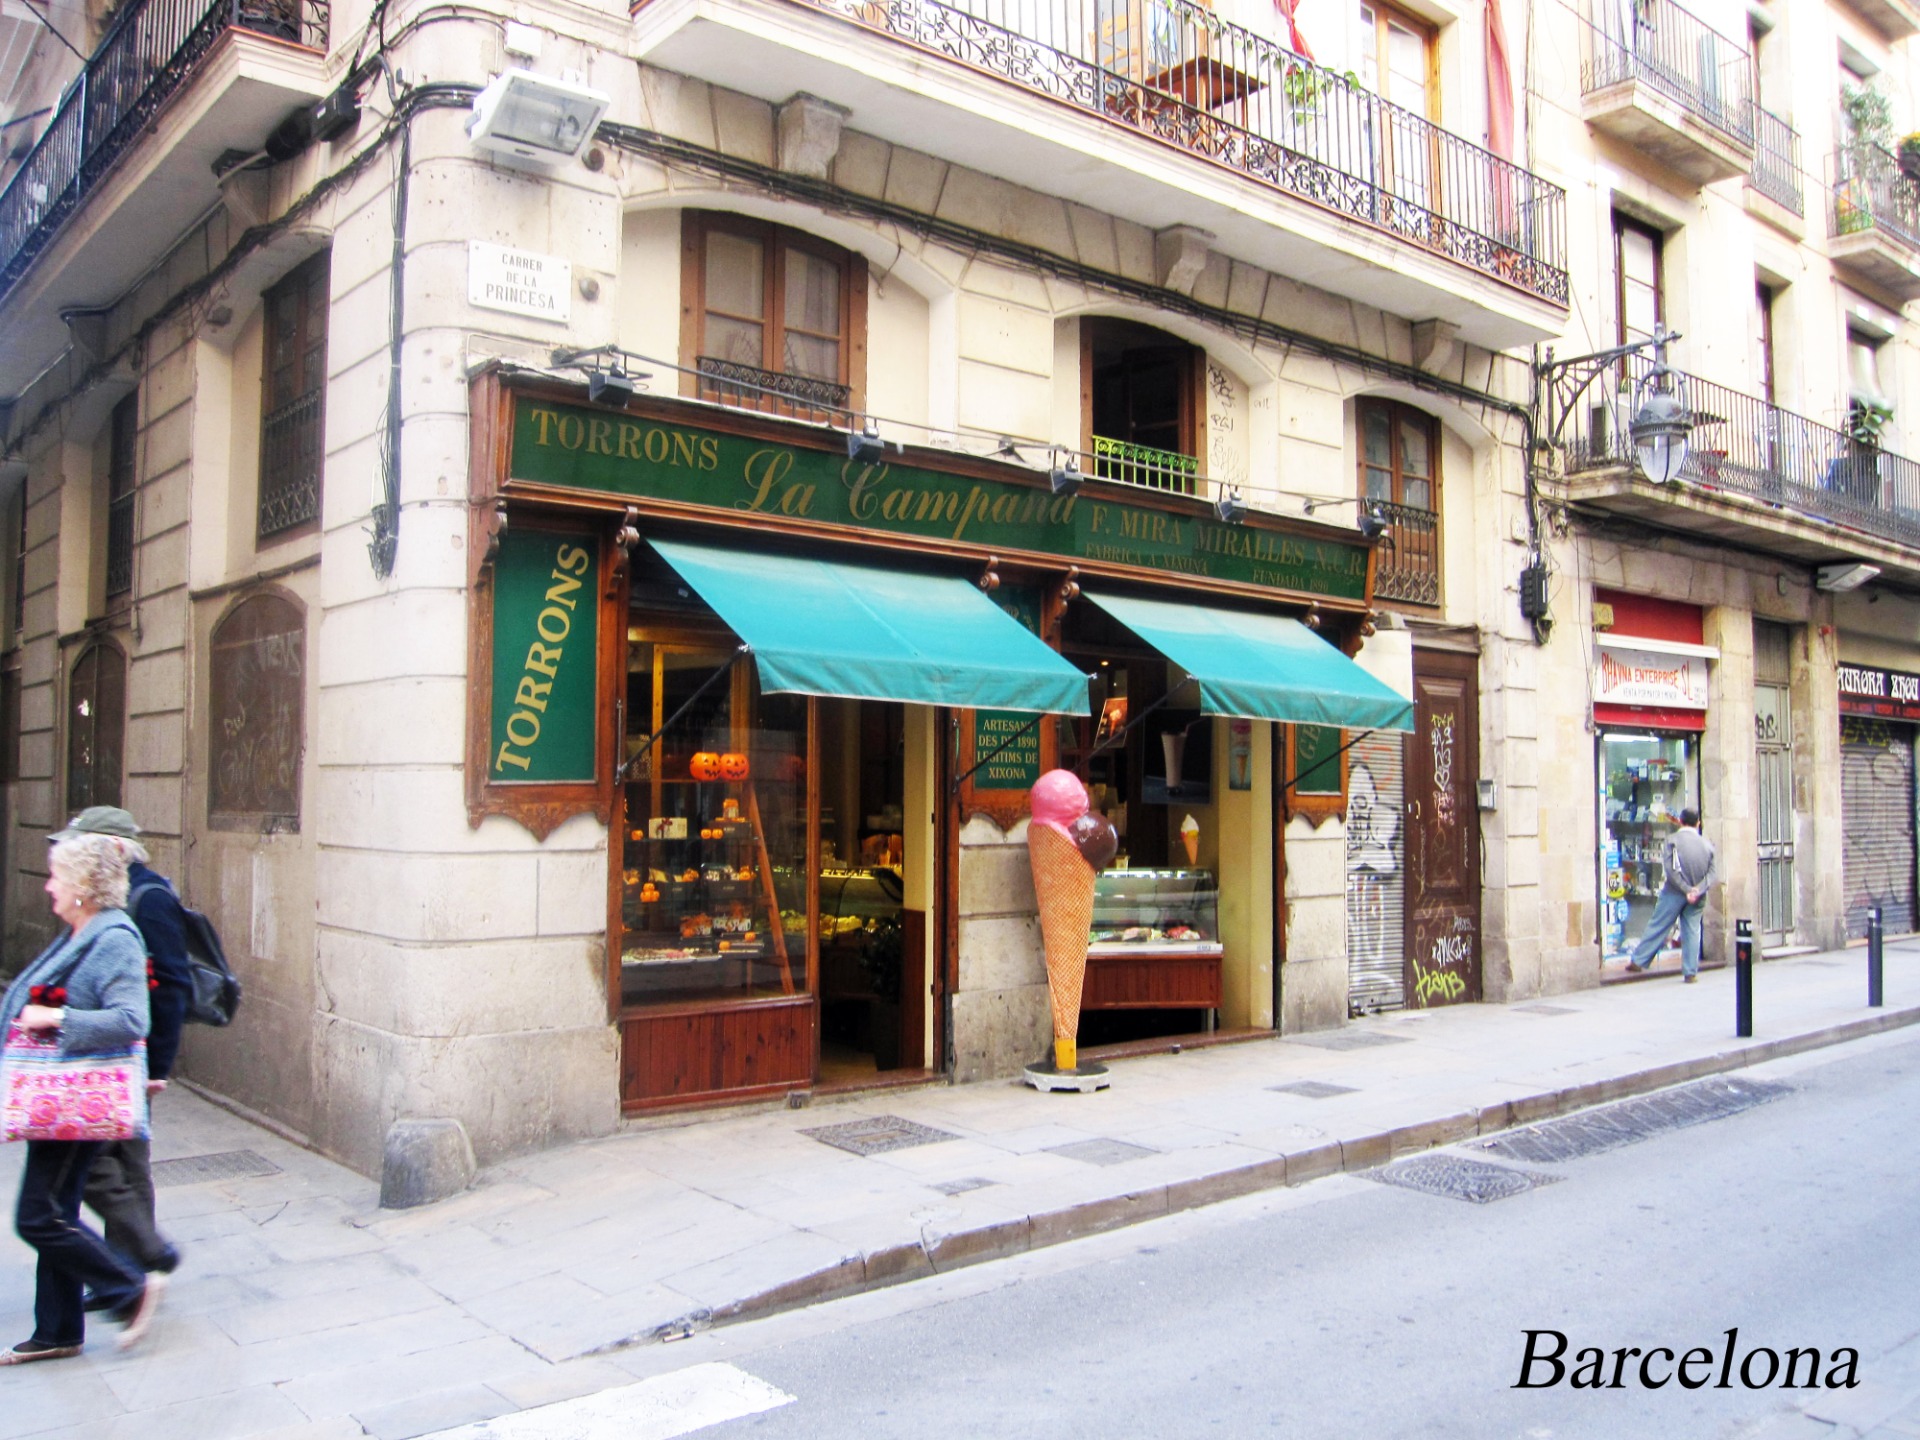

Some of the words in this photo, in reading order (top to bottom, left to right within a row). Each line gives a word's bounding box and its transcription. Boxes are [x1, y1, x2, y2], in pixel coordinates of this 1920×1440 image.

[502, 253, 543, 272] CARRER
[506, 271, 520, 285] DE
[524, 275, 537, 288] LA
[486, 283, 555, 310] PRINCESA
[531, 408, 719, 471] TORRONS
[733, 449, 816, 517] La
[841, 460, 1078, 540] Campana
[1091, 504, 1112, 535] F.
[1119, 509, 1182, 545] MIRA
[1194, 524, 1306, 567] MIRALLES
[1252, 569, 1305, 590] FUNDADA
[495, 543, 590, 772] TORRONS
[1602, 652, 1633, 694] BHAVNA
[1635, 667, 1680, 690] ENTERPRISE
[1837, 667, 1885, 697] AURORA
[979, 735, 998, 747] DES
[1017, 737, 1037, 749] 1890
[1025, 753, 1038, 765] DE
[989, 767, 1026, 779] XIXONA
